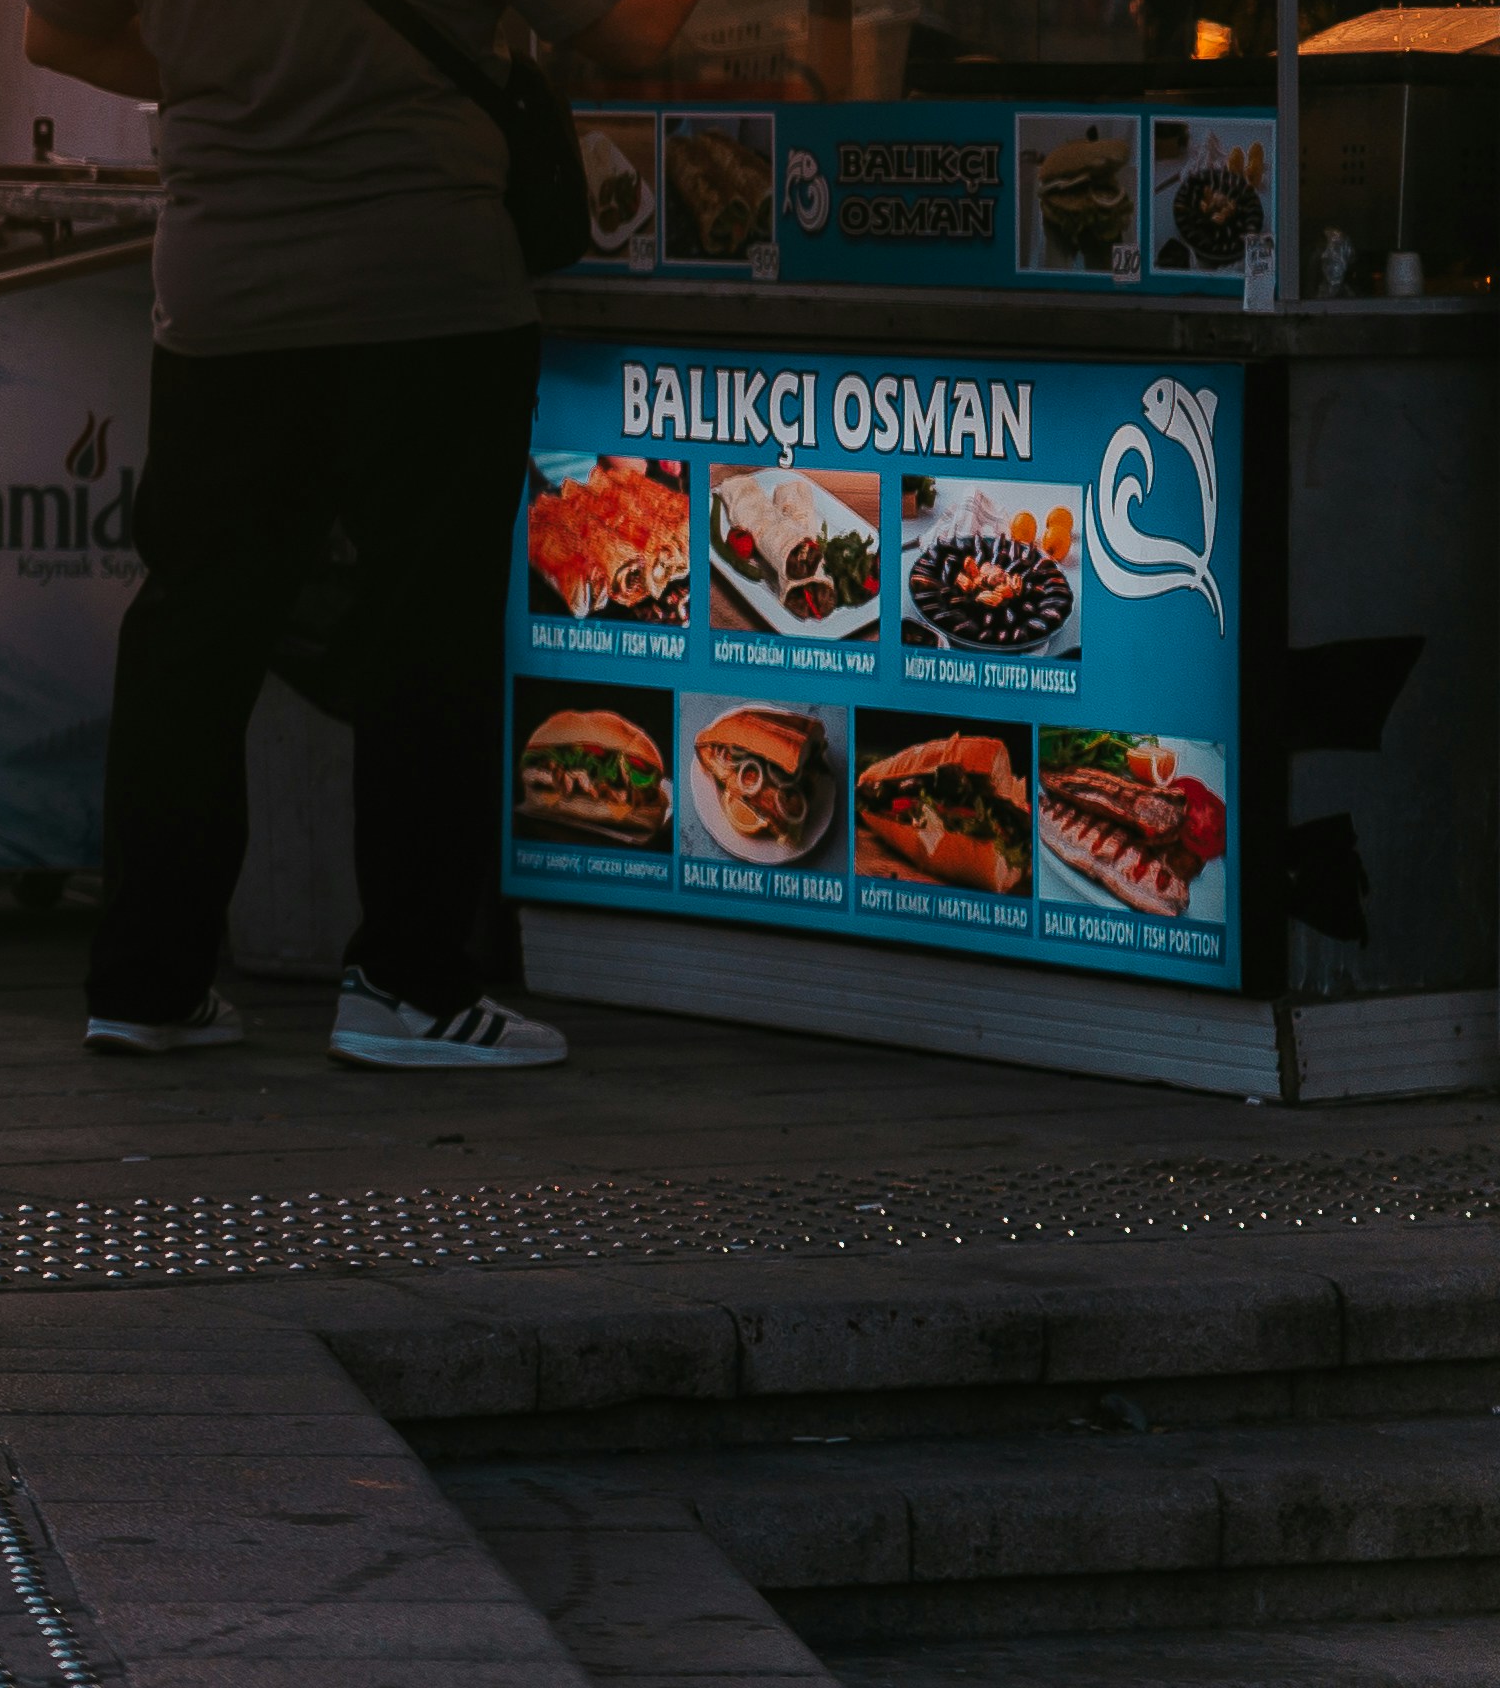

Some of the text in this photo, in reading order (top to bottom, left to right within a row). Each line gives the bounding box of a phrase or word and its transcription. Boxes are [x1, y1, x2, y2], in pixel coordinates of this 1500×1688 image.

[839, 144, 999, 194] BALIKÇI
[839, 196, 995, 238] OSMAN
[622, 362, 1032, 469] BALIKÇI OSMAN
[17, 556, 94, 587] Kaynak
[532, 624, 565, 649] BALIK
[622, 631, 646, 658] FISH
[649, 634, 686, 661] WRAP
[845, 651, 875, 674] WRAP
[938, 661, 976, 685] DOLMA
[984, 663, 1029, 690] STUFFED
[1030, 667, 1077, 694] MUSSELS
[683, 861, 719, 889] BALIK
[722, 867, 763, 894] EKMEK
[773, 872, 799, 899] FISH
[803, 877, 843, 903] BREAD
[896, 891, 930, 916] EKMEK
[938, 897, 991, 924] MEATBALL
[994, 904, 1028, 930] BREAD
[1045, 911, 1076, 937] BALIK
[1143, 925, 1166, 952] FISH
[1169, 929, 1220, 958] PORTION
